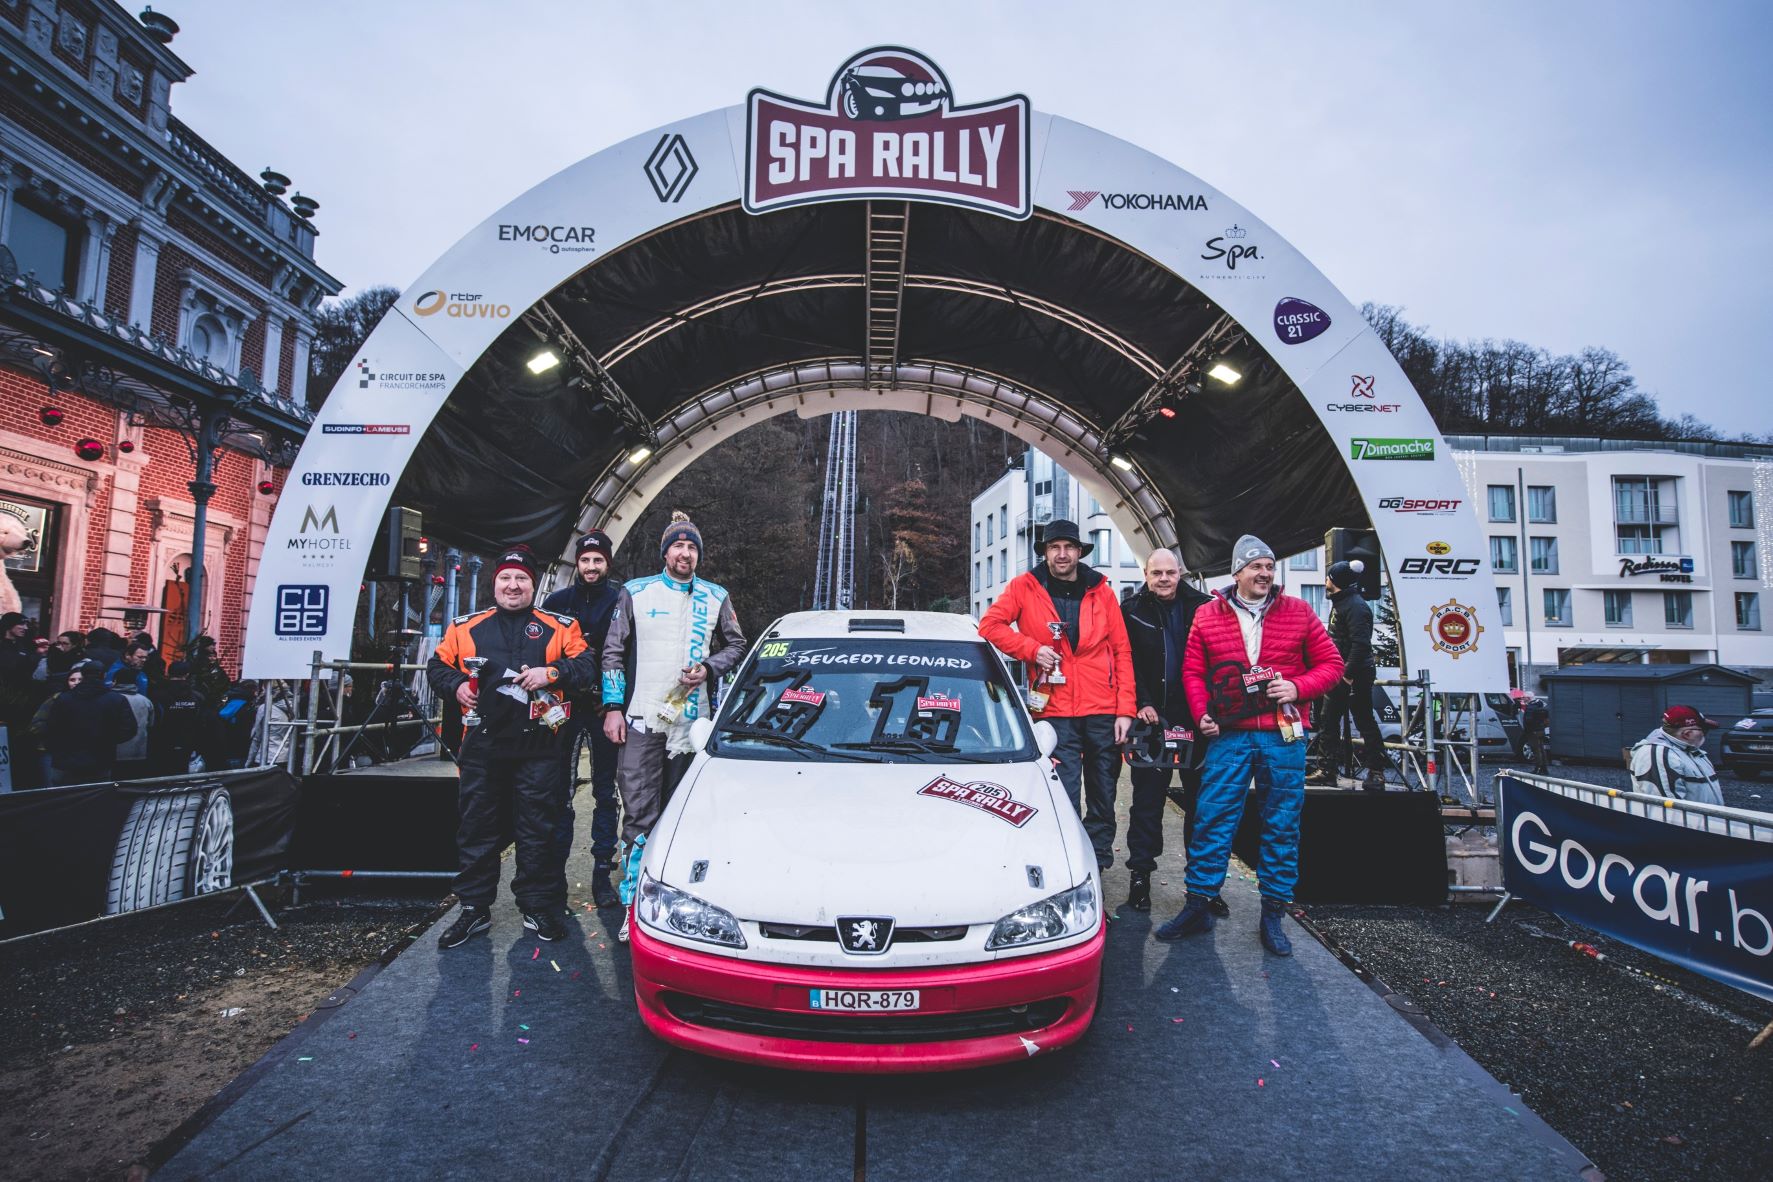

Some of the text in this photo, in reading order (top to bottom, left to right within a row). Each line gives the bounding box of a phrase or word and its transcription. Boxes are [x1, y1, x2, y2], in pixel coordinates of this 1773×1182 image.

[768, 119, 1006, 189] SPA RALLY
[1100, 193, 1208, 211] YOKOHAMA
[498, 224, 595, 243] EMOCAR
[447, 303, 511, 318] auvio
[1277, 312, 1321, 326] CLASSIC
[1287, 325, 1303, 338] 21
[380, 373, 413, 381] CIRCUIT
[379, 382, 447, 390] FRANCORCHAMPS
[1326, 403, 1401, 413] CYBERNET
[1352, 440, 1433, 460] 7 Dimanche
[301, 472, 391, 486] GRENZECHO
[1378, 499, 1462, 509] DG SPORT
[287, 538, 351, 550] MYHOTEL
[1398, 558, 1481, 575] BRC
[760, 642, 789, 657] 205
[1439, 640, 1471, 652] SPORT
[797, 653, 973, 670] PEUGEOT LEONARD
[974, 784, 1001, 797] 205
[931, 781, 971, 798] SPA
[971, 792, 1027, 818] RALLY
[825, 991, 915, 1010] HQR-879
